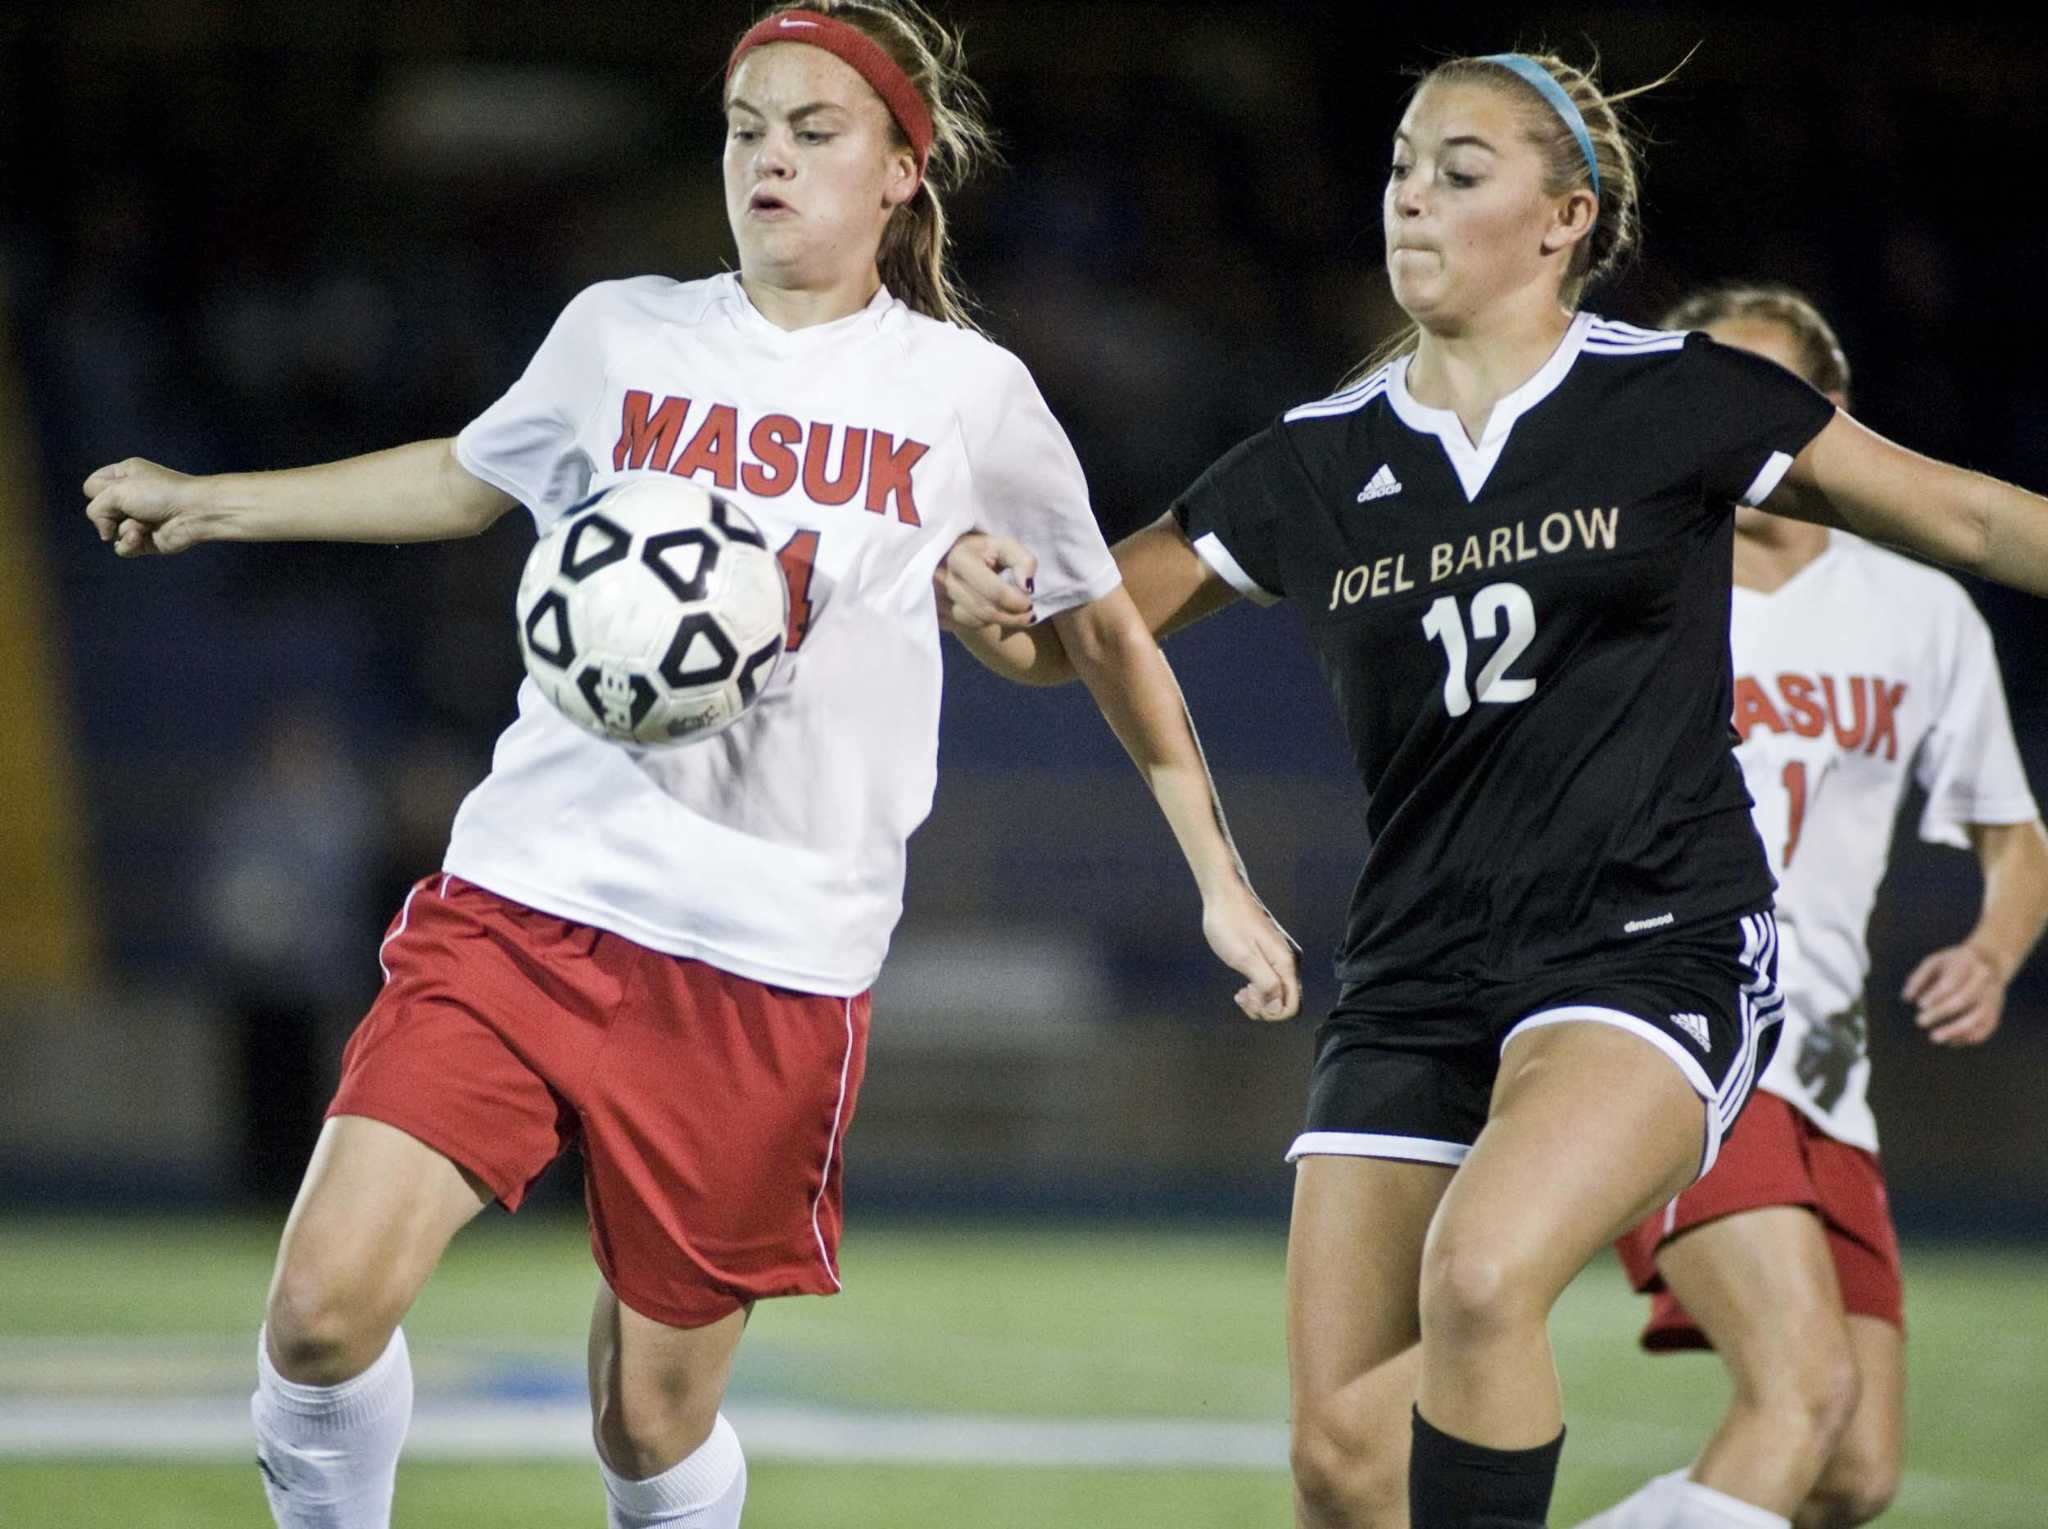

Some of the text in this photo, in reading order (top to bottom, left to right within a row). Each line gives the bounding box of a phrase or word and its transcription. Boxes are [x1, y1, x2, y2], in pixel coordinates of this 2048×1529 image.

[613, 389, 930, 528] MASUK
[1329, 507, 1619, 611] JOEL BARLOW
[1421, 582, 1537, 717] 12
[1733, 673, 1907, 762] ASUK
